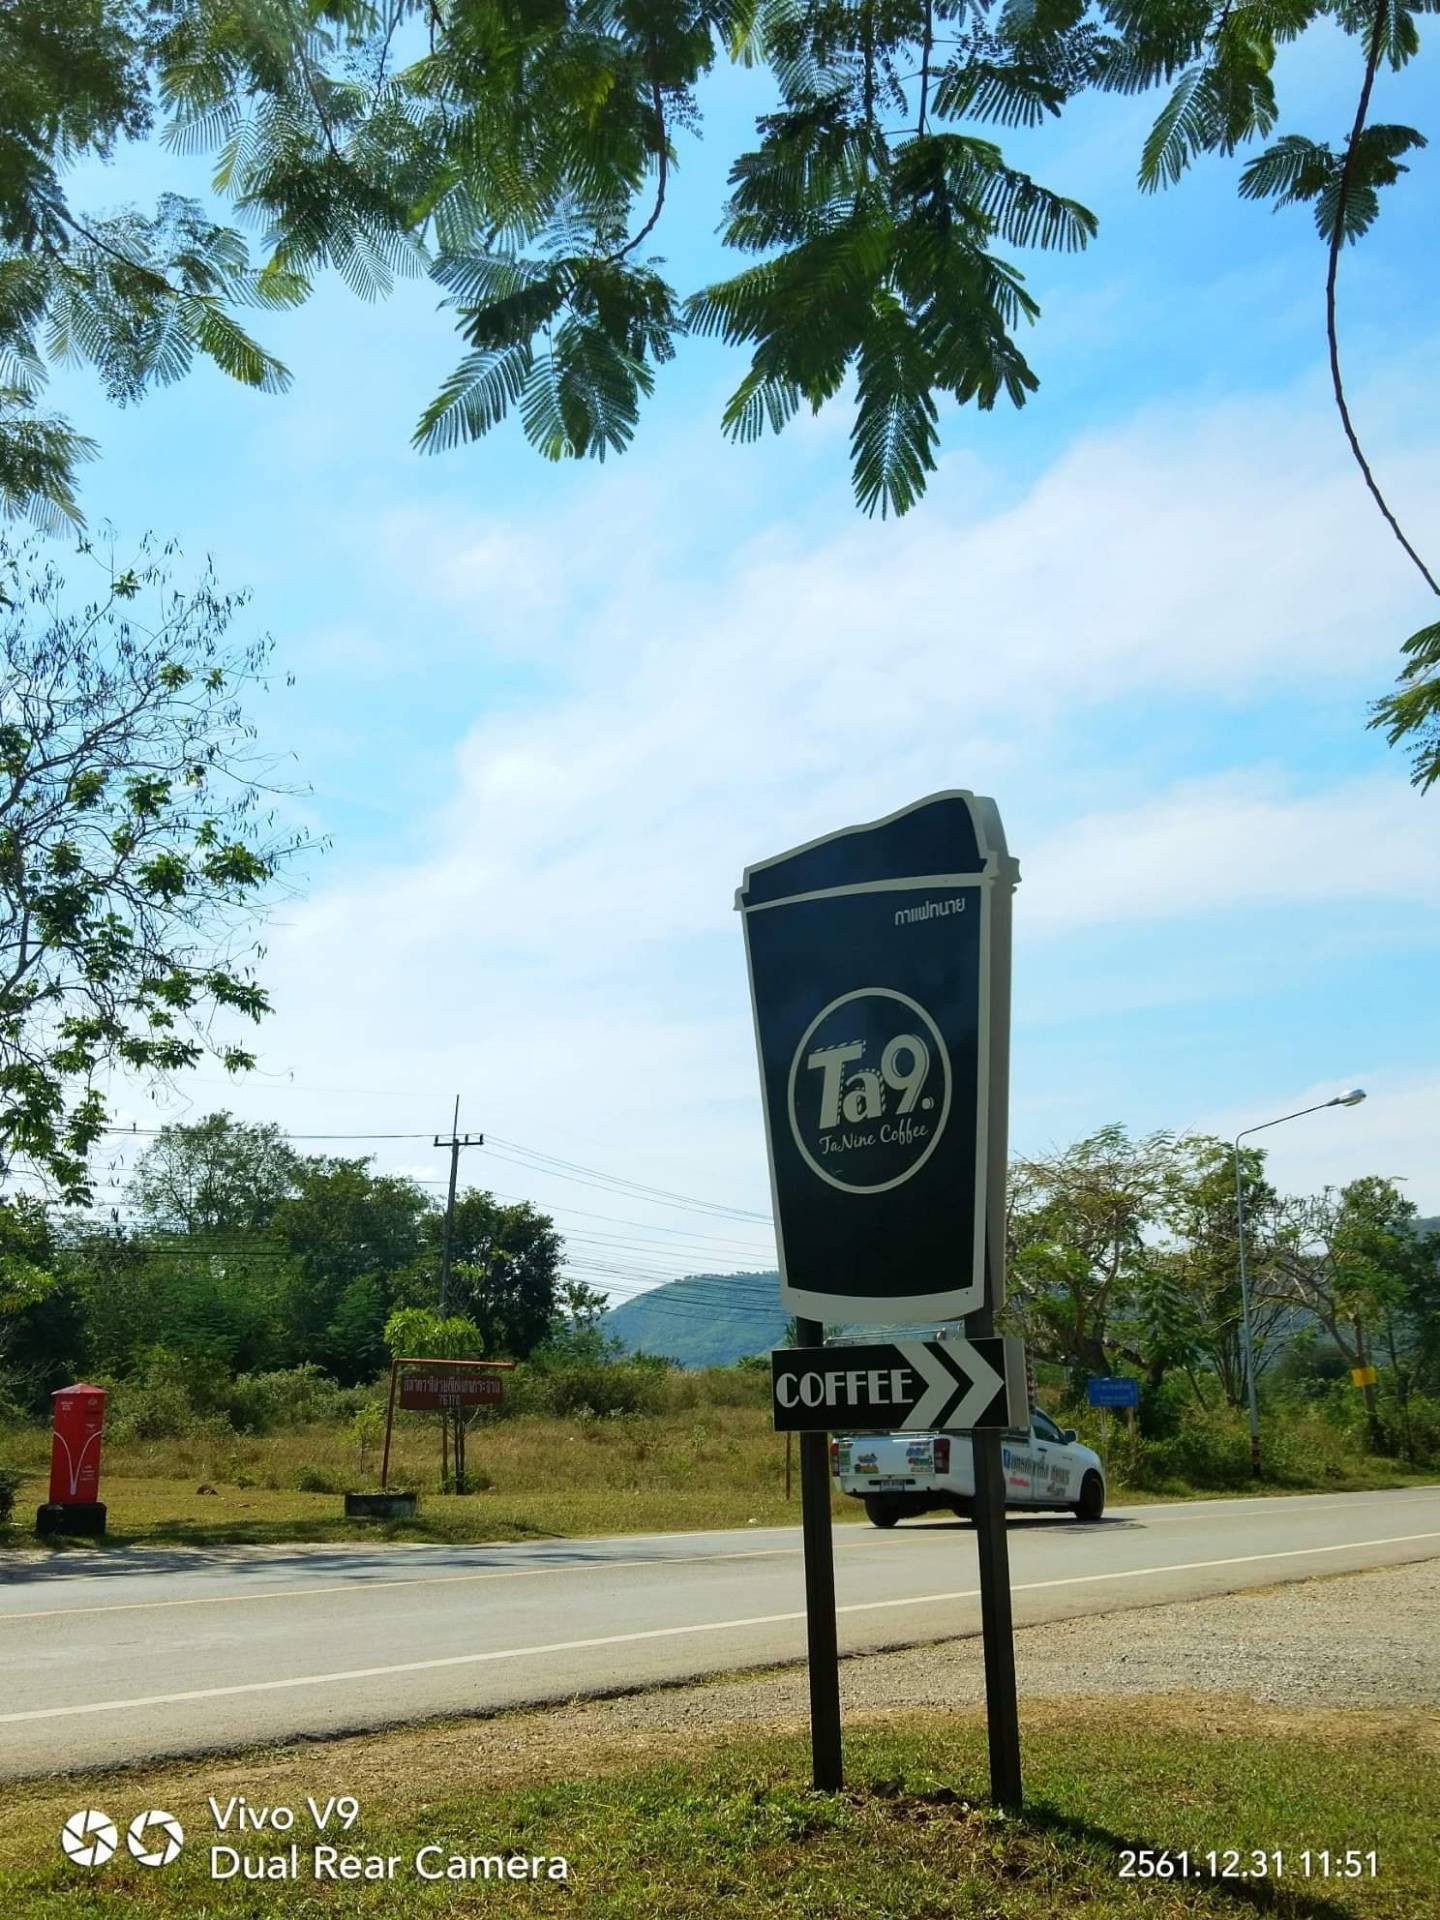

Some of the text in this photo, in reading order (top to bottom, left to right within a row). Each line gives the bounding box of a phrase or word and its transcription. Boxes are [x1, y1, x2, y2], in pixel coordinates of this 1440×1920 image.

[894, 897, 966, 926] กาแฟทนาย
[880, 1117, 930, 1146] Coffee
[775, 1368, 914, 1408] COFFEE
